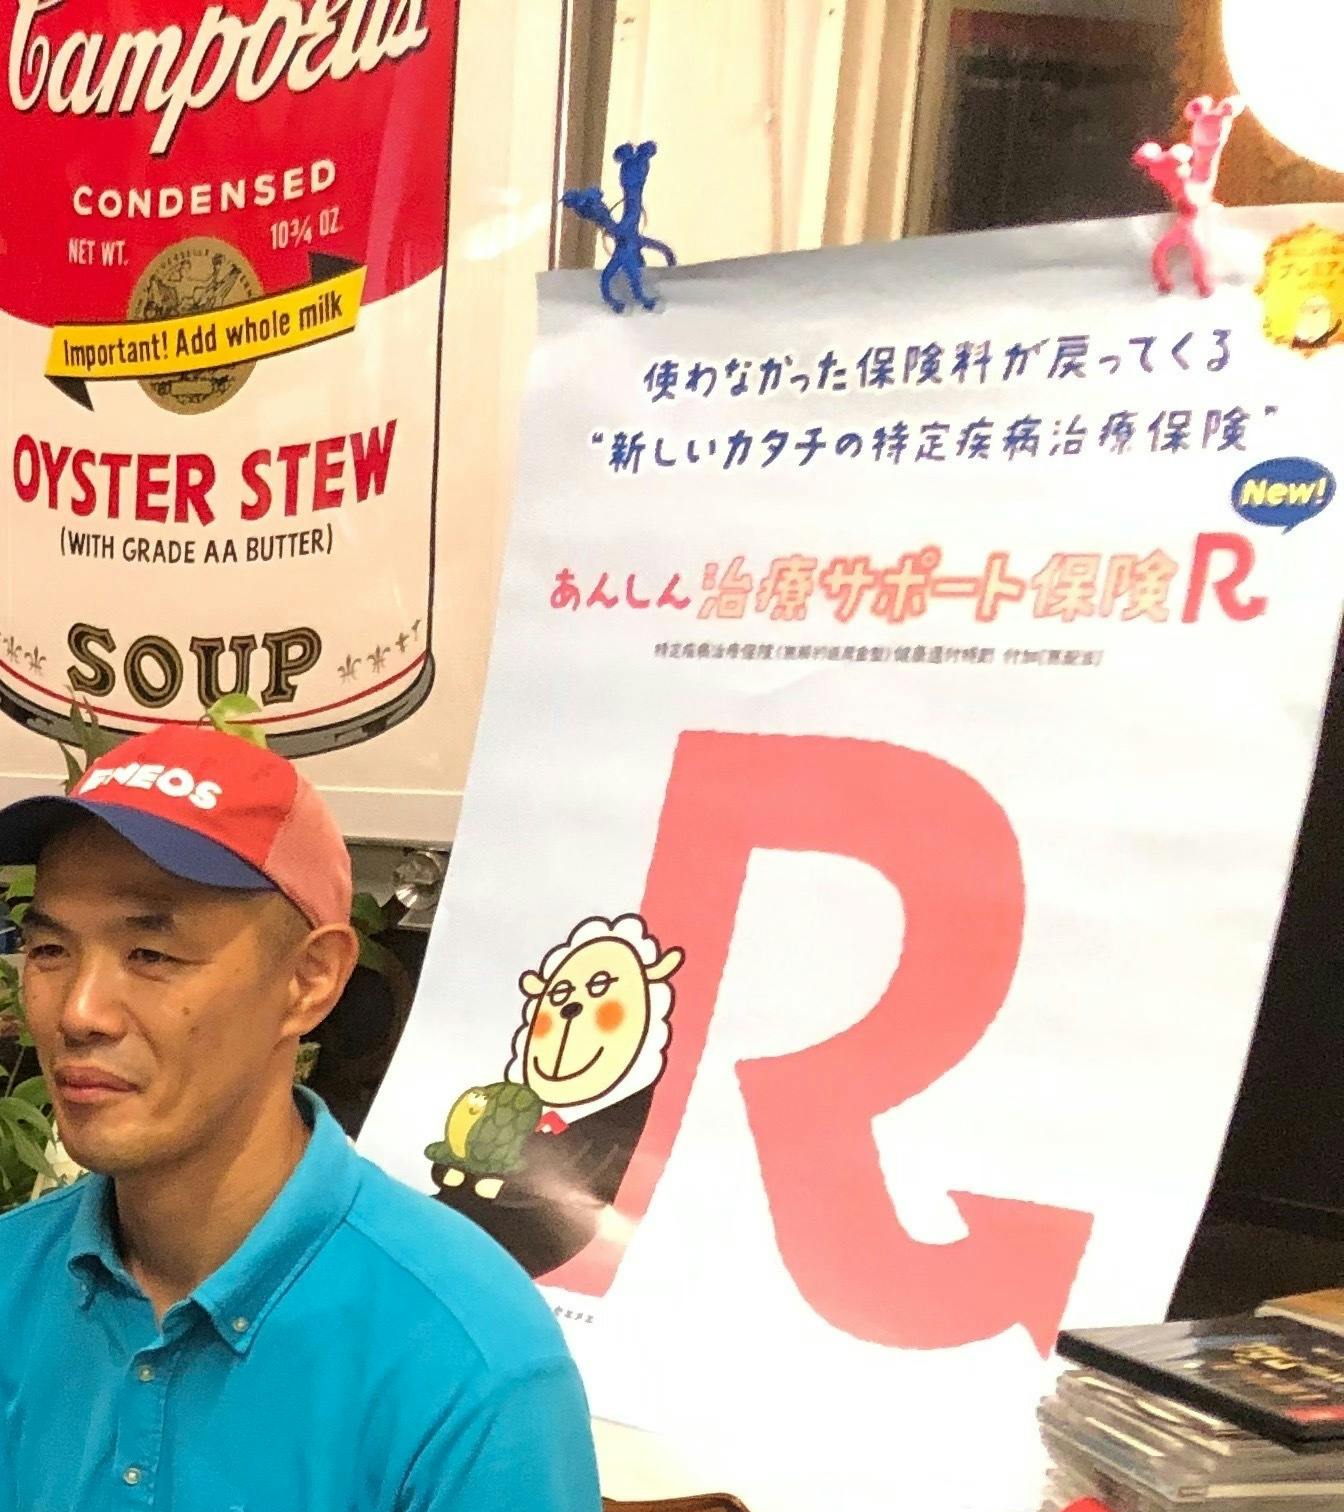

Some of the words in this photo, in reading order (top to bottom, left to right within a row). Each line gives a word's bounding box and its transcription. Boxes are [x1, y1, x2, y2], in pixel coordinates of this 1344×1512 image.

[72, 159, 337, 219] CONDENSED
[68, 238, 97, 265] NET
[101, 239, 128, 266] WT.
[64, 331, 169, 371] Important!
[176, 323, 217, 355] Add
[226, 310, 290, 347] whole
[299, 290, 343, 331] milk
[643, 328, 1232, 403] 使わなかった保険料が戻ってくる
[13, 434, 216, 527] OYSTER
[240, 418, 398, 521] STEW
[1240, 477, 1326, 517] New!
[60, 526, 115, 561] (WITH
[122, 536, 196, 564] GRADE
[204, 538, 238, 564] AA
[246, 523, 333, 563] BUTTER)
[67, 622, 322, 709] SOUP
[78, 761, 223, 810] ENEOS
